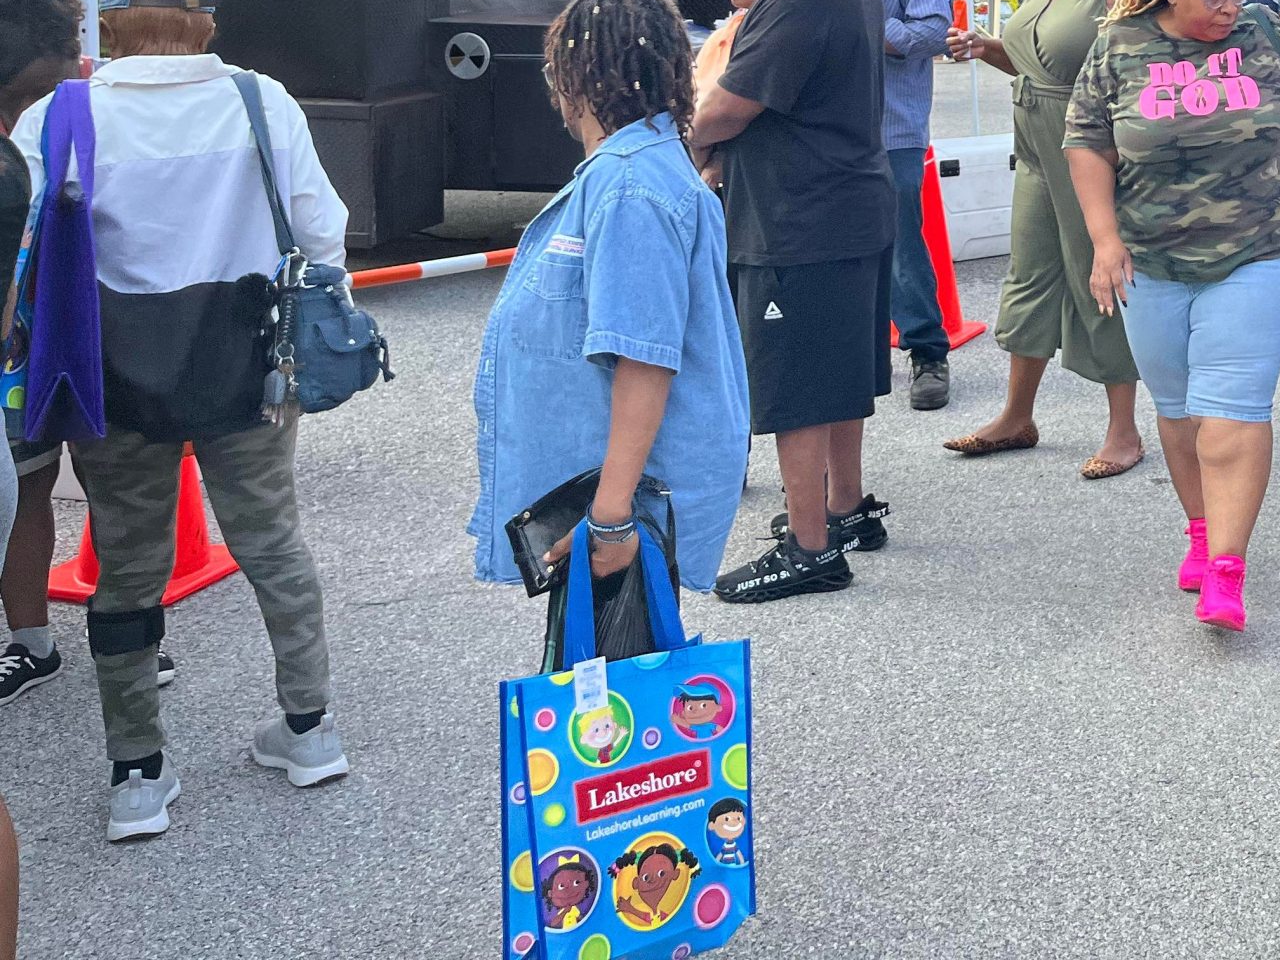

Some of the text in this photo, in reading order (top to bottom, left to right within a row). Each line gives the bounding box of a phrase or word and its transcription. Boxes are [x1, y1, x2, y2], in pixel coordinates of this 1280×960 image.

[1146, 47, 1243, 87] DO IT
[1139, 75, 1261, 120] GOD
[841, 536, 861, 553] JUS
[735, 577, 761, 593] JUST
[763, 573, 778, 584] SO
[587, 767, 697, 811] Lakeshore
[586, 797, 706, 842] LakeshoreLearning.com
